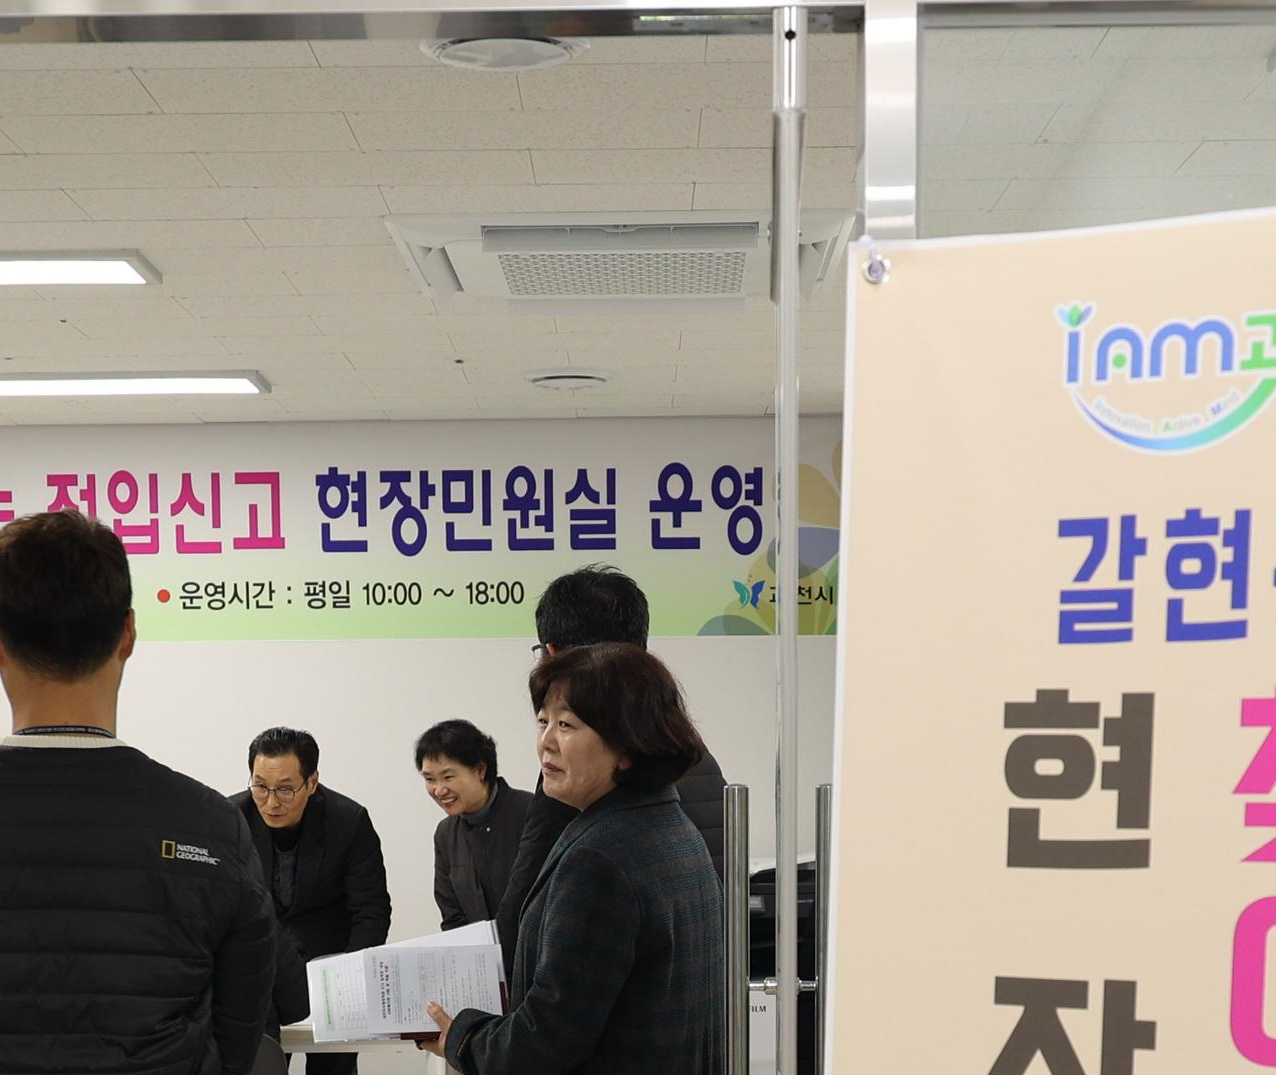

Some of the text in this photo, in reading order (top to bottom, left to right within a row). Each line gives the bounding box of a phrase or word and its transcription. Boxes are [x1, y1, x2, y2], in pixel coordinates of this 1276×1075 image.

[315, 465, 619, 557] 현장민원실
[649, 462, 764, 556] 운영
[179, 581, 276, 611] 운영시간
[304, 580, 351, 610] 평일
[362, 581, 422, 606] 10:00
[465, 580, 525, 606] 18:00
[176, 844, 209, 856] NATIONAL
